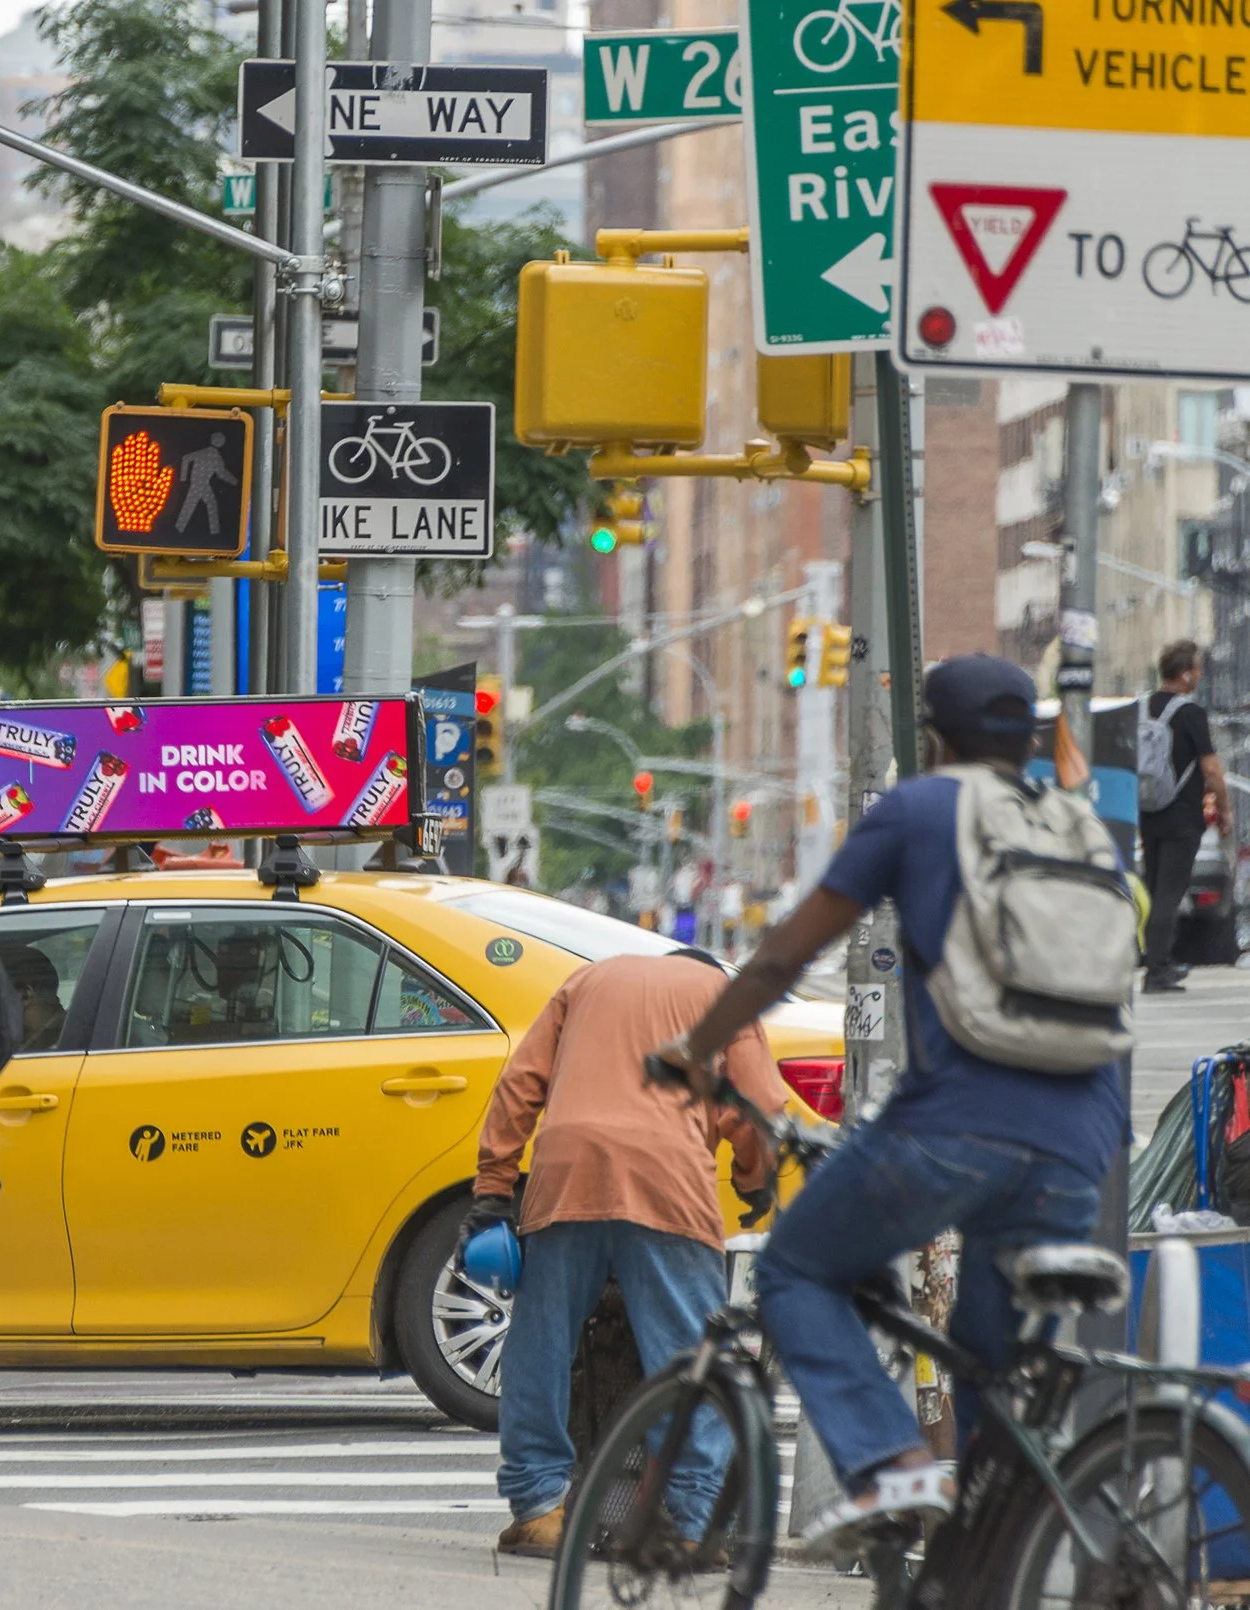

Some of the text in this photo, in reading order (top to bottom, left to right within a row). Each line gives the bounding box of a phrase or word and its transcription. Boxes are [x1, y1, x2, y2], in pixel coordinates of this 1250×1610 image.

[599, 45, 649, 112] W
[330, 95, 514, 133] NE WAY
[799, 105, 901, 154] Ea
[230, 178, 253, 207] W
[788, 166, 894, 221] Riv
[972, 217, 1022, 234] YIELD
[1068, 232, 1125, 279] TO
[322, 505, 477, 540] IKE LANE
[352, 701, 375, 741] ULY
[161, 744, 244, 766] DRINK
[274, 744, 314, 800] TRULY
[139, 770, 267, 793] IN COLOR
[348, 772, 390, 826] TRULY
[66, 771, 104, 830] TRULY
[171, 1131, 222, 1141] METERED
[172, 1143, 199, 1152] FARE
[283, 1127, 340, 1138] FLAT FARE
[283, 1140, 303, 1150] JFK
